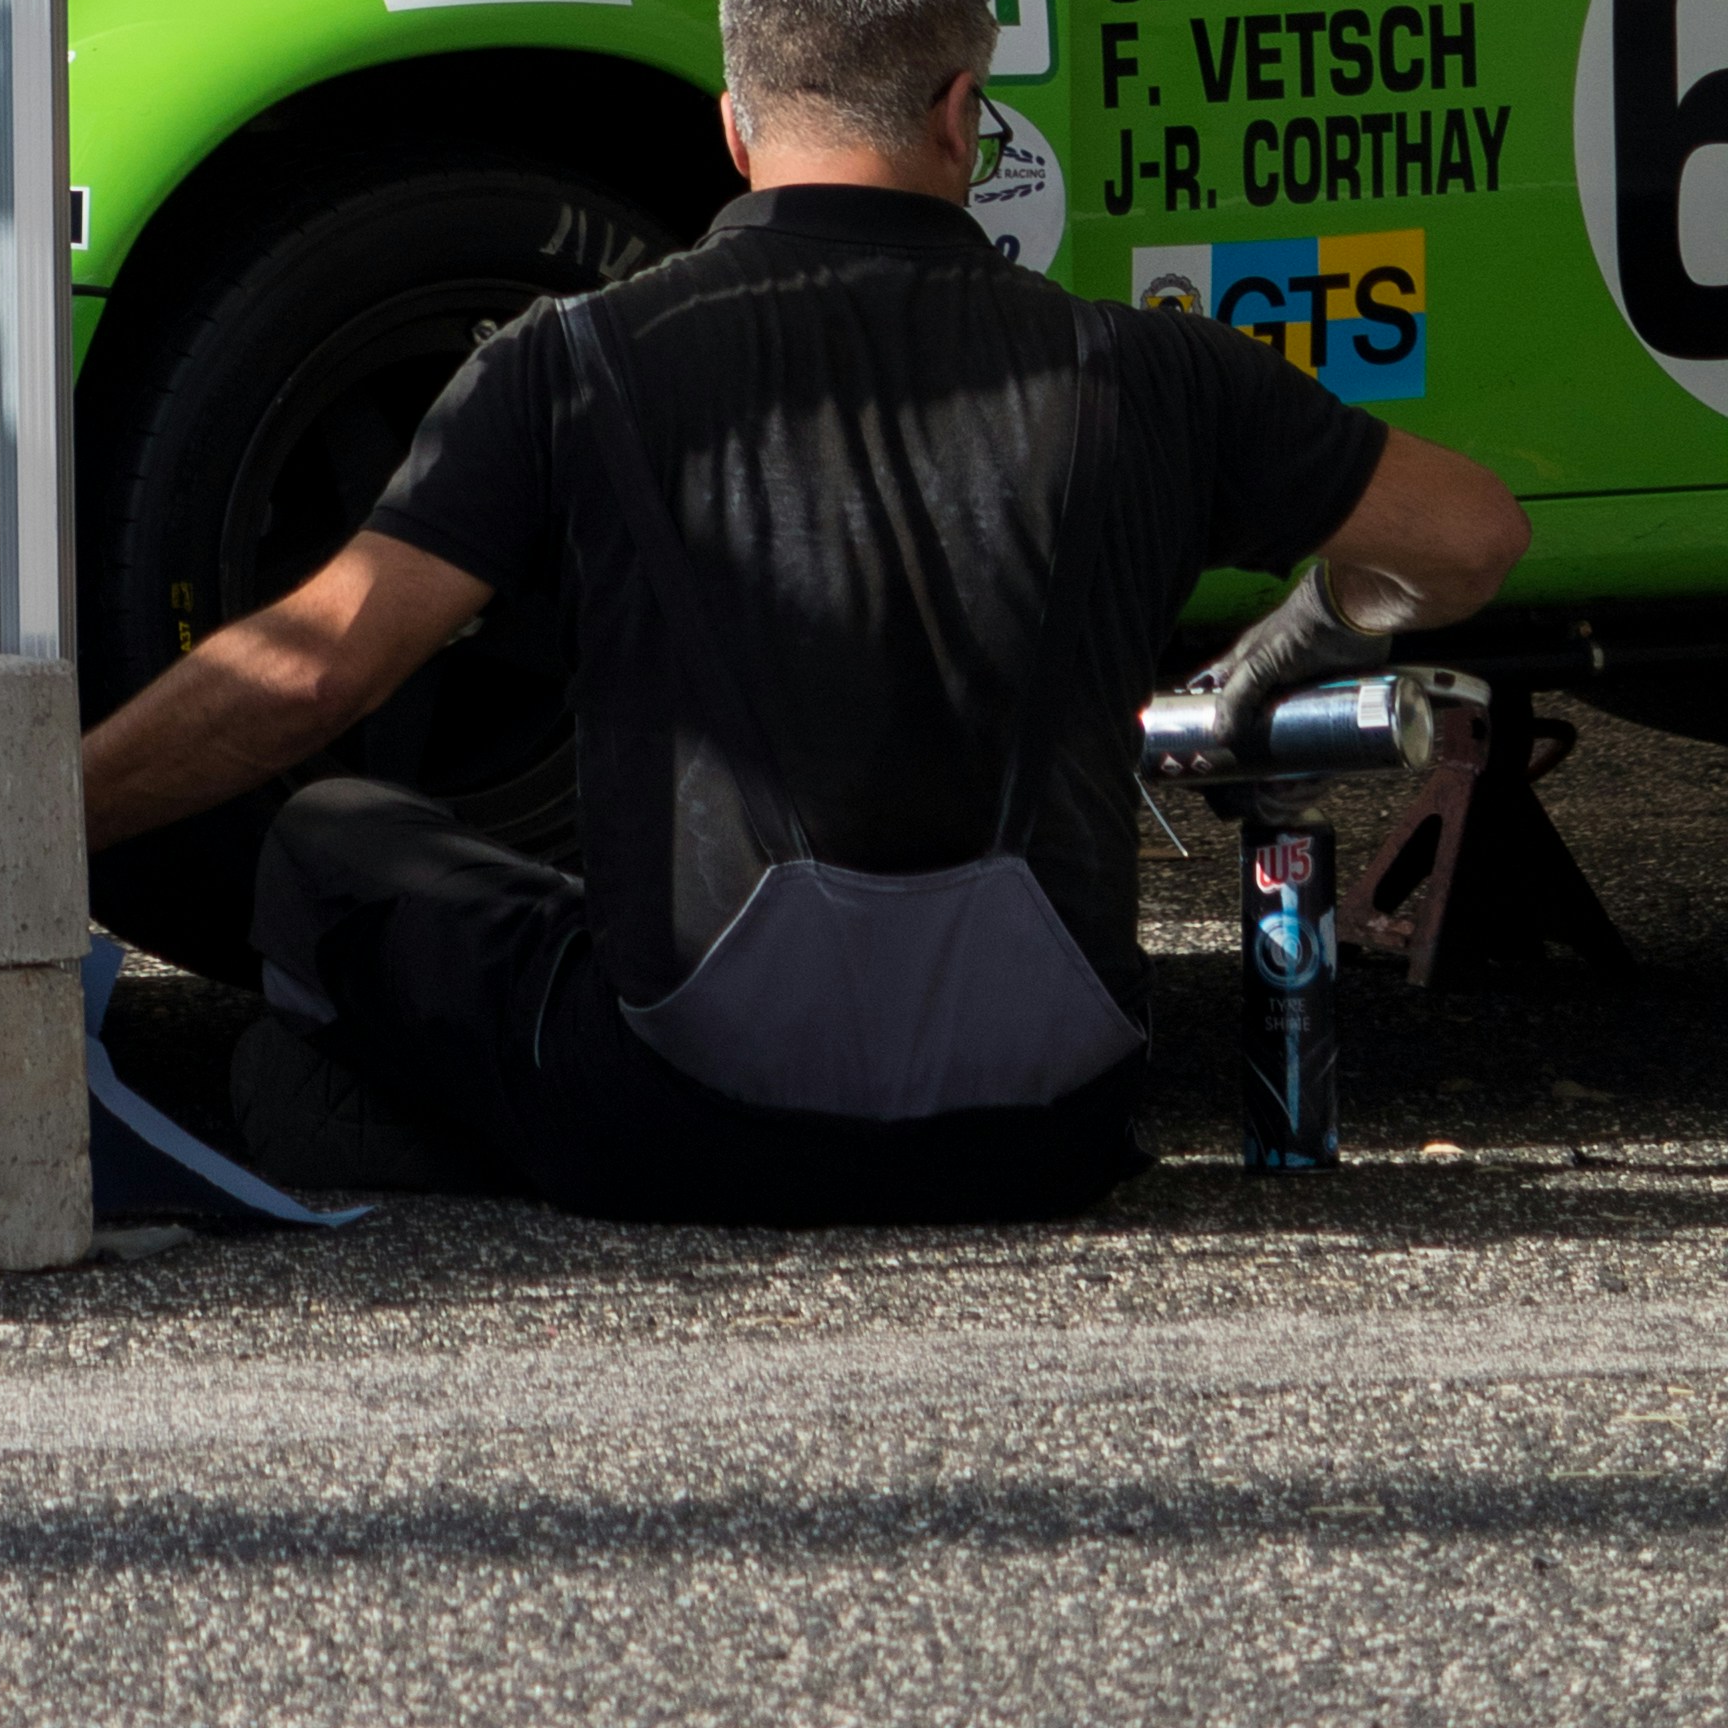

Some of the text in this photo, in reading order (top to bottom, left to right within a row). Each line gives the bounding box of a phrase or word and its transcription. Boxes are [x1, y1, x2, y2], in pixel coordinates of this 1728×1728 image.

[1101, 2, 1478, 109] F. VETSCH
[1004, 168, 1046, 179] RACING
[1104, 105, 1512, 217] J-R. CORTHAY
[1216, 265, 1418, 368] GTS
[1255, 837, 1313, 894] W5
